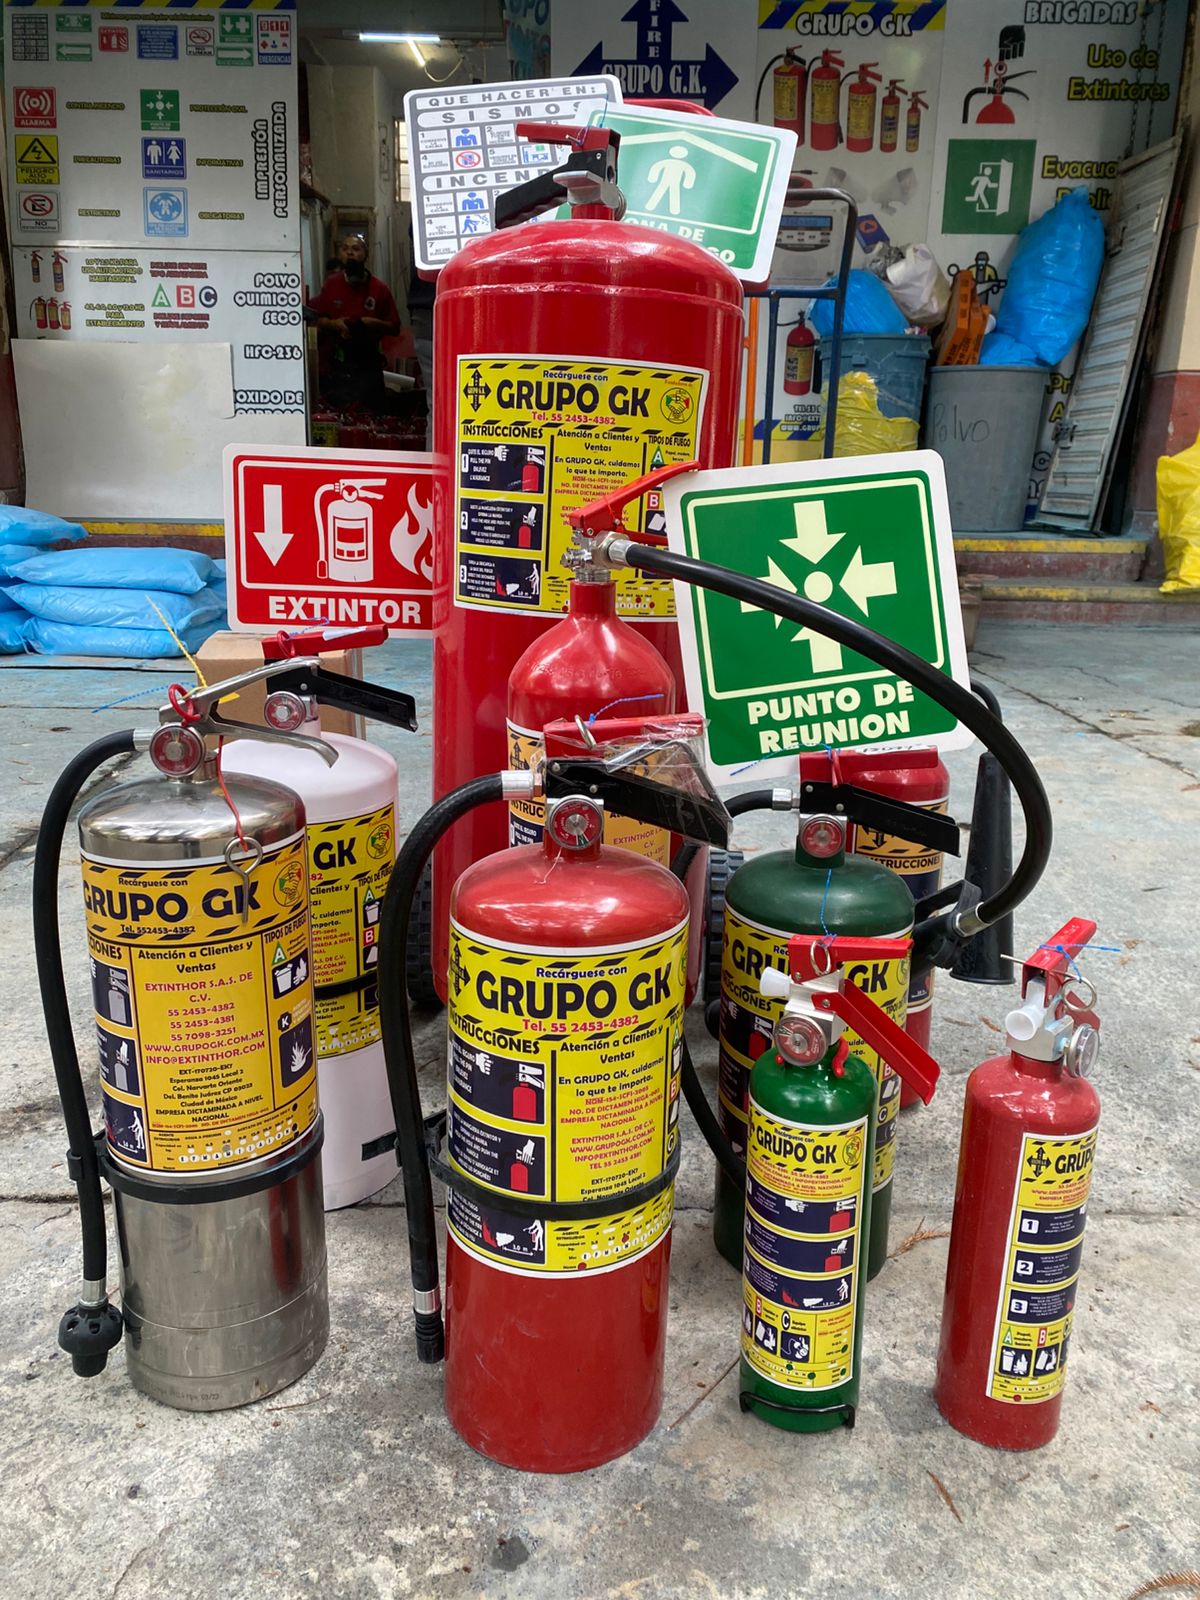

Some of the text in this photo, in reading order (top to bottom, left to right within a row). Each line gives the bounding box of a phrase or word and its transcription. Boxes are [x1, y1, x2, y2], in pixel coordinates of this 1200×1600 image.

[1025, 1, 1137, 24] BRIGADAS
[796, 11, 912, 37] GRUPO GK
[1088, 44, 1158, 68] Uso de
[601, 63, 708, 94] GRUPO G.K.
[429, 95, 468, 107] QUE
[482, 87, 550, 102] HACER
[1068, 77, 1170, 101] Extintores
[251, 119, 269, 200] IMPRESIÓN
[271, 102, 288, 218] PERSONALIZADA
[677, 225, 705, 242] DE
[254, 273, 300, 289] POLVO
[200, 287, 215, 306] C
[234, 291, 300, 307] QUIMICO
[263, 310, 301, 326] SECO
[244, 344, 302, 360] HFC-236
[543, 370, 591, 381] Recárguese
[284, 391, 304, 405] DE
[496, 379, 651, 417] GRUPO GK
[531, 411, 616, 425] Tel. 55 2453-4382
[932, 403, 990, 443] Polvo
[463, 425, 544, 438] INSTRUCCIONES
[557, 429, 640, 443] Atención Clientes y
[584, 442, 612, 451] Ventas
[649, 436, 691, 447] TIPOS DE FUEGO
[565, 456, 592, 465] GRUPO
[594, 458, 607, 467] GK,
[608, 460, 640, 468] cuidamos
[269, 595, 421, 624] EXTINTOR
[747, 682, 914, 725] PUNTO DE
[758, 710, 910, 754] REUNION
[313, 837, 357, 870] GK
[867, 855, 940, 869] TRUCCIONES
[118, 877, 188, 887] Recárguese con
[84, 880, 261, 923] GRUPO GK
[120, 924, 134, 933] Tel.
[264, 929, 283, 944] TIPOS
[138, 949, 188, 960] Atención
[200, 942, 244, 957] Clientes
[246, 941, 253, 950] y
[274, 948, 285, 961] A
[176, 962, 216, 974] Ventas
[536, 965, 628, 979] Recárguese con
[145, 971, 253, 992] EXTINTHOR S.A.S. DE
[848, 961, 890, 993] GK
[189, 993, 211, 1003] C.V.
[476, 962, 672, 1020] GRUPO GK
[168, 1003, 235, 1017] 55 2453-4382
[184, 1015, 235, 1028] 2453-4381
[522, 1014, 639, 1032] Tel. 55 2453-4382
[145, 1030, 264, 1053] WWW.GRUPOGK.COM.MX
[186, 1027, 236, 1040] 7098-3251
[560, 1040, 609, 1052] Atención
[623, 1029, 657, 1045] Clientes
[146, 1041, 266, 1064] INFO@EXTINTHOR.COM
[600, 1050, 635, 1064] Ventas
[558, 1055, 664, 1085] En GRUPO GK, cuidamos
[576, 1074, 653, 1097] lo que te importa.
[187, 1102, 236, 1115] DICTAMINADA
[244, 1094, 264, 1105] NIVEL
[598, 1098, 633, 1112] DICTAMEN
[192, 1112, 229, 1122] NACIONAL
[600, 1115, 636, 1129] NACIONAL
[572, 1132, 615, 1144] EXTINTHOR
[756, 1126, 837, 1165] GRUPO GK
[590, 1162, 602, 1170] TEL
[1020, 1262, 1030, 1272] 2
[1014, 1302, 1023, 1311] 3
[1039, 1330, 1046, 1345] B
